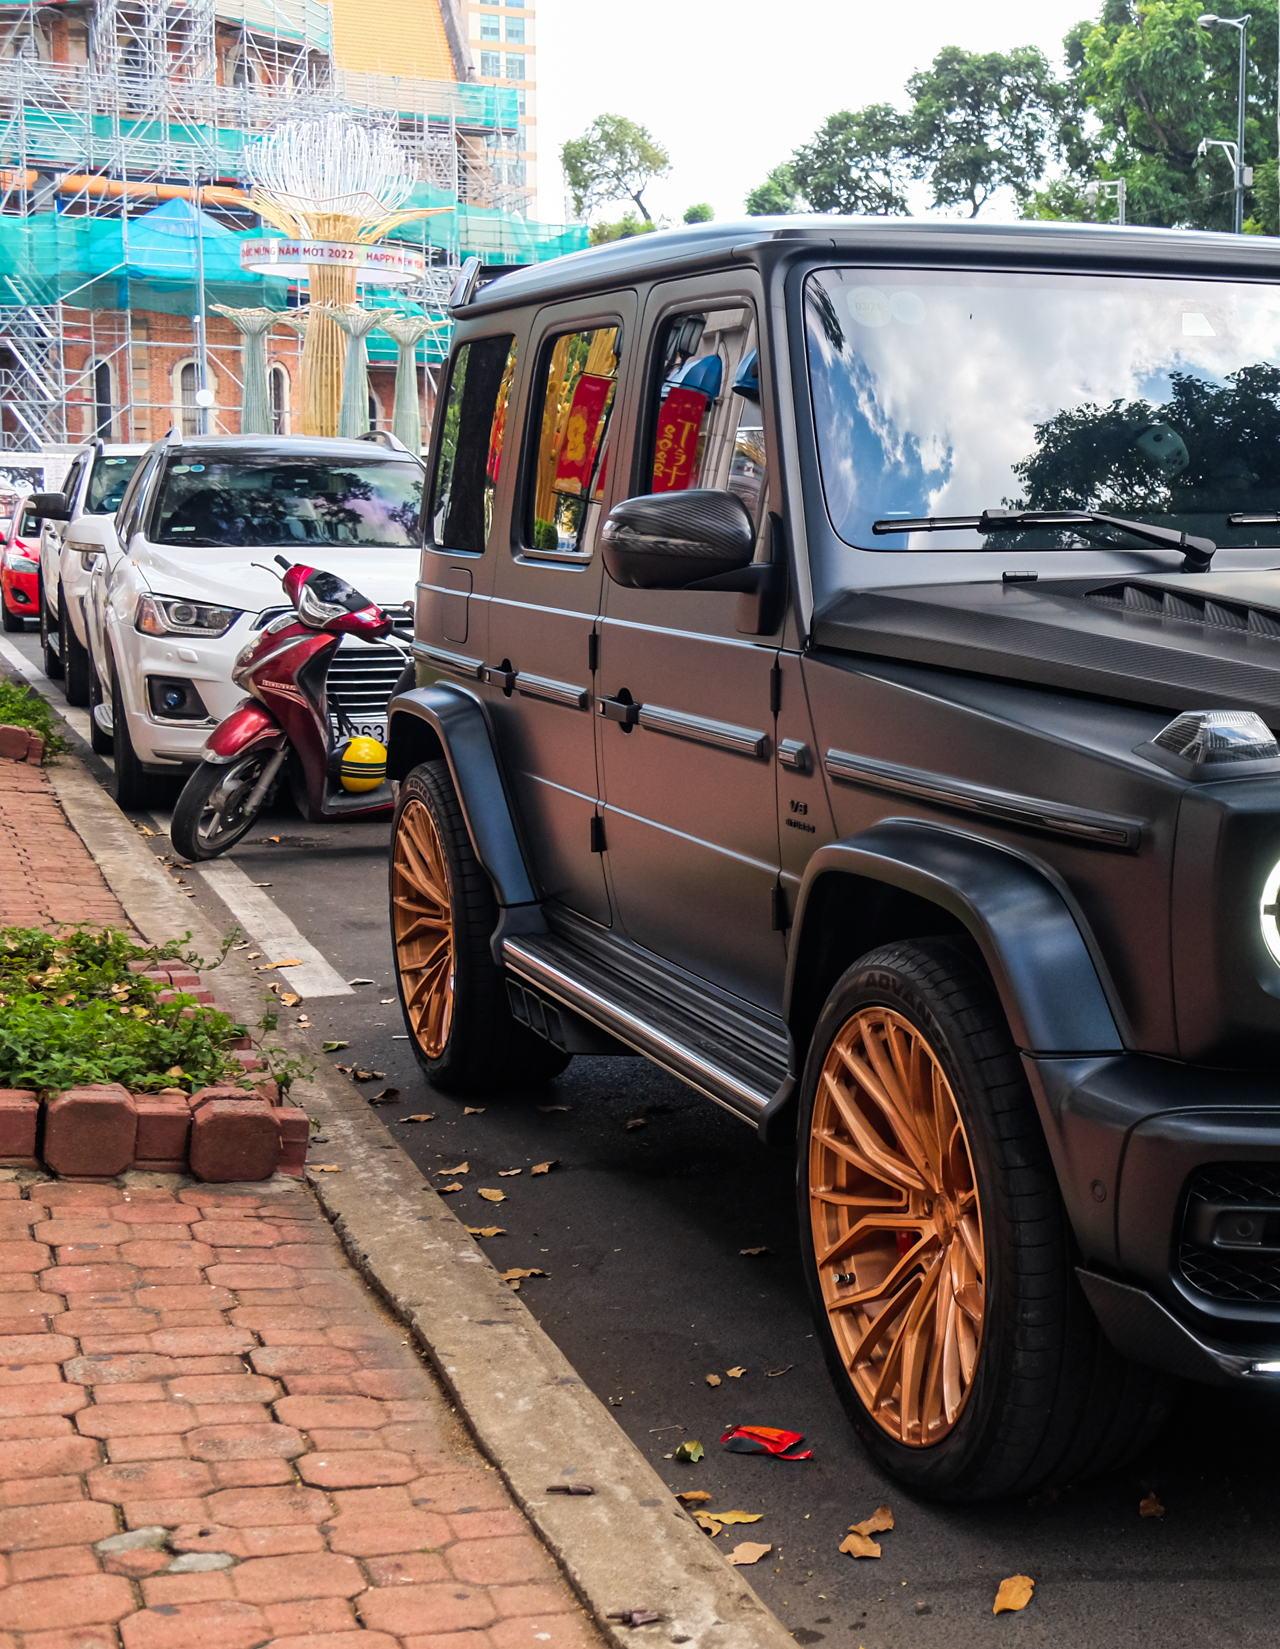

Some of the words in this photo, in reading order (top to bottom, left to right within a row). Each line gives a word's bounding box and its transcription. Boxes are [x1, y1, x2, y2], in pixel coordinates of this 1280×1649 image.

[278, 244, 300, 256] NĂM
[303, 245, 324, 257] MỚI
[328, 248, 354, 260] 2022
[366, 252, 395, 264] HAPPY
[789, 799, 808, 815] V8
[864, 972, 932, 1028] ADVAN
